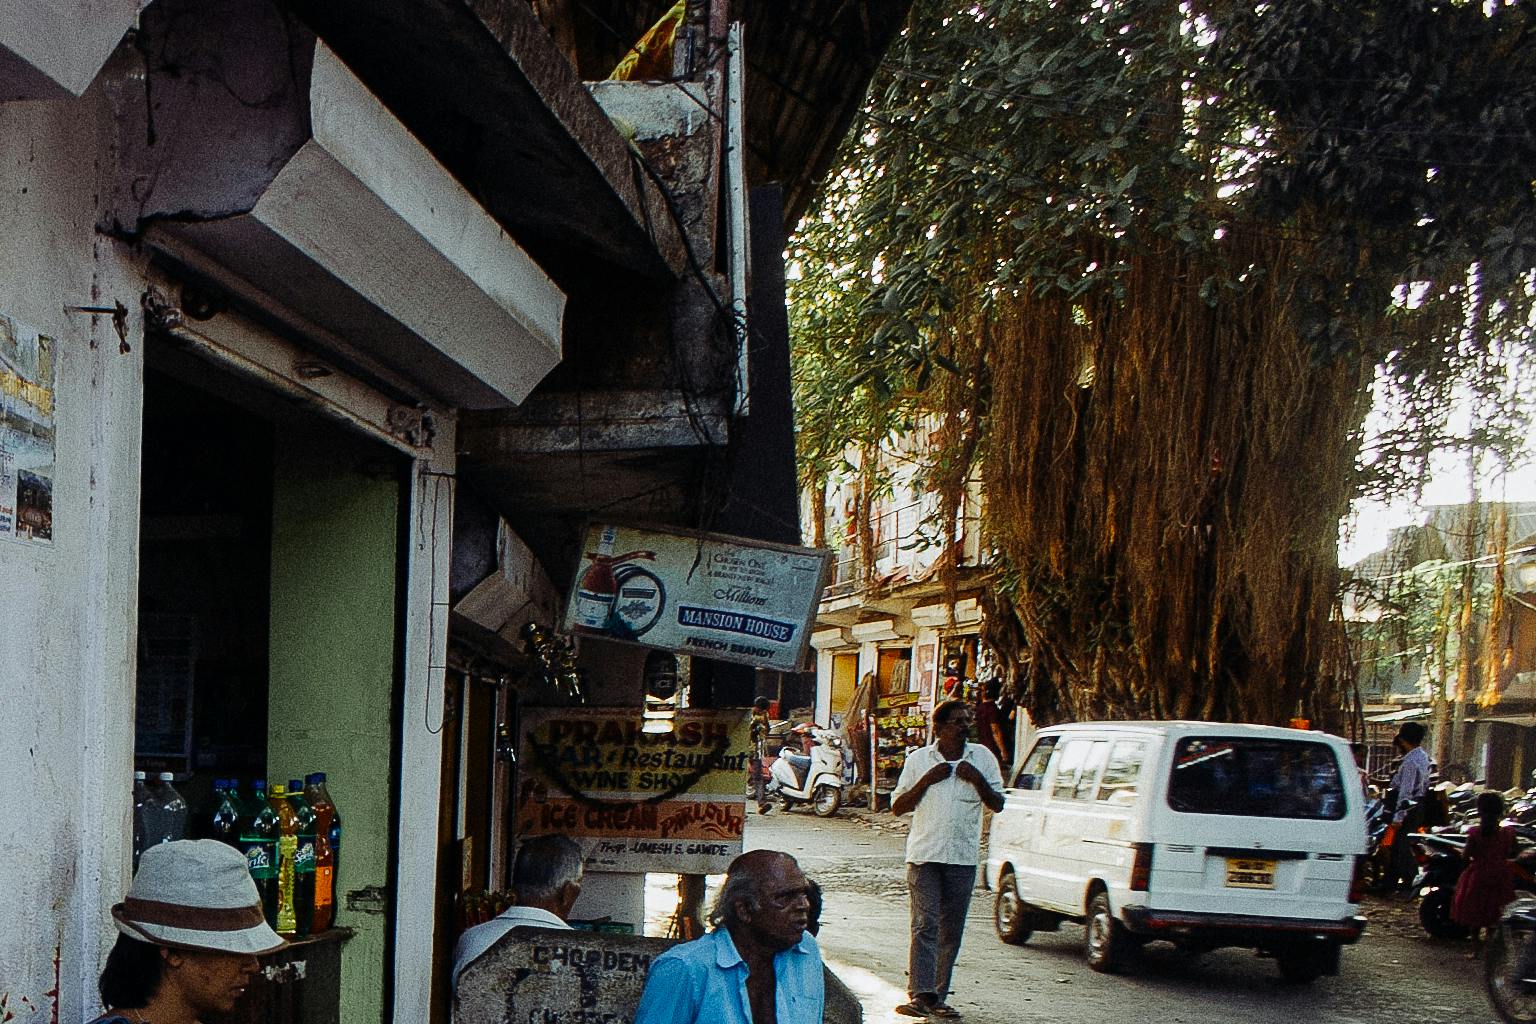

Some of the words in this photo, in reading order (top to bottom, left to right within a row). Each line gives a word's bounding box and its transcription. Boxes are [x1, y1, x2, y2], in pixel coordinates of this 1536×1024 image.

[682, 609, 744, 630] MANSION
[745, 617, 790, 640] HOUSE
[686, 637, 728, 650] FRENCH
[730, 643, 776, 659] BRANDY
[549, 719, 729, 747] PRAKSH
[621, 748, 748, 771] Restaunt
[575, 771, 628, 789] WINE
[639, 771, 686, 791] SHO
[541, 804, 577, 830] ICE
[584, 804, 658, 831] CREAM
